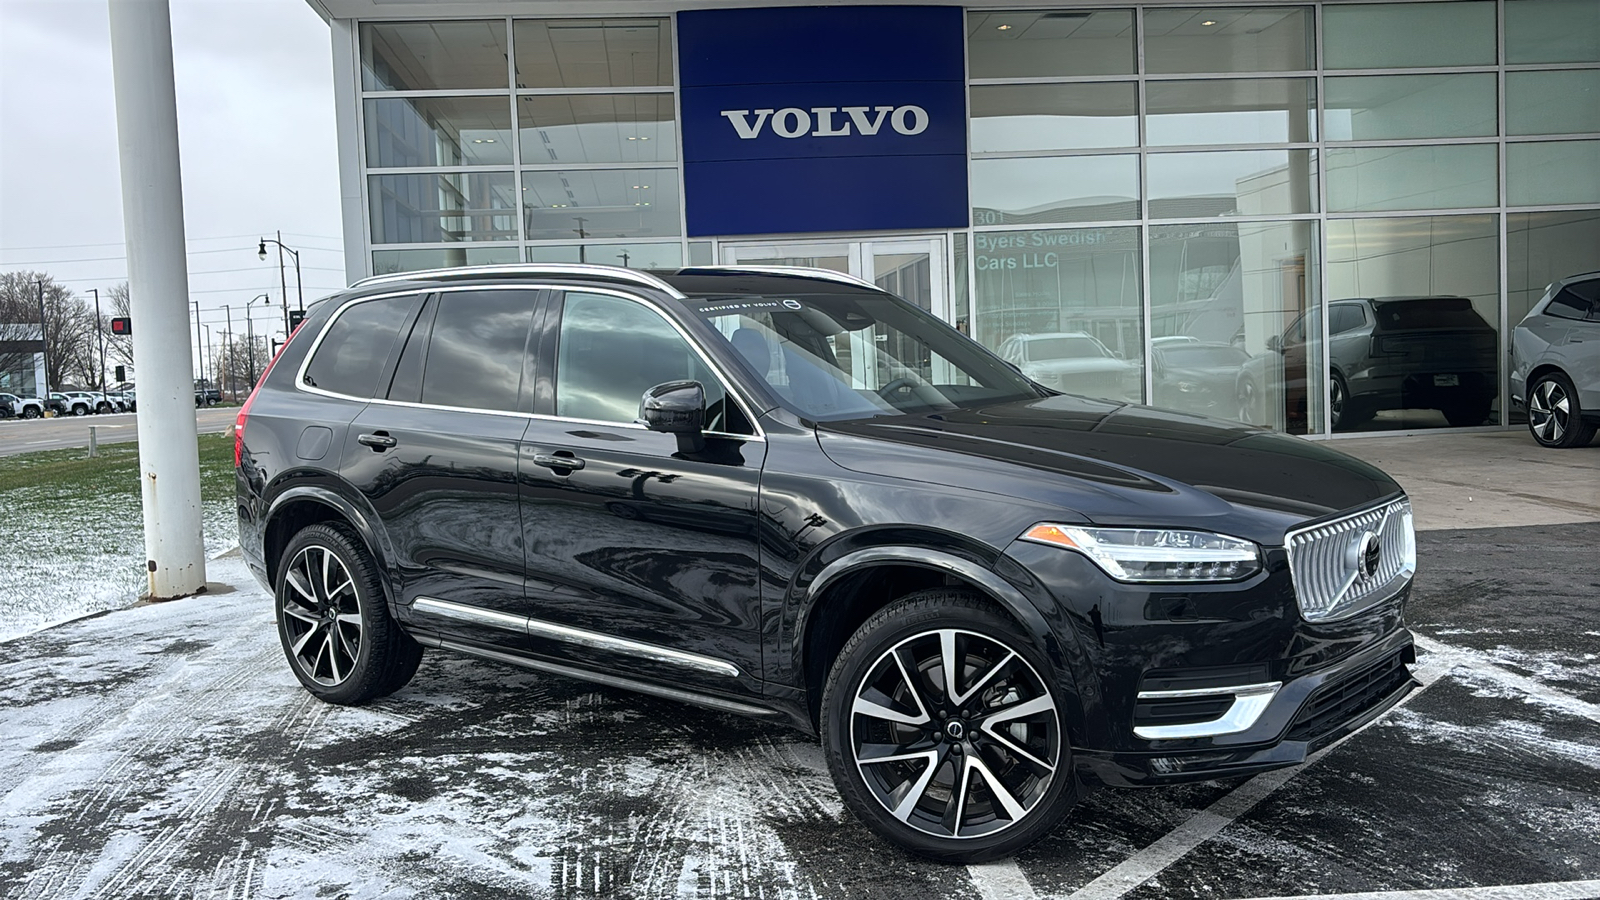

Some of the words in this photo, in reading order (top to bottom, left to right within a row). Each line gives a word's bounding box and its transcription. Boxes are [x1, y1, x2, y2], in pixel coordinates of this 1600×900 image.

[721, 105, 929, 139] VOLVO
[974, 210, 1005, 225] 301
[975, 234, 1026, 253] Byers
[1032, 231, 1107, 247] Swedish
[975, 255, 1017, 271] Cars
[1023, 252, 1058, 269] LLC
[699, 304, 740, 312] CERTIFIED
